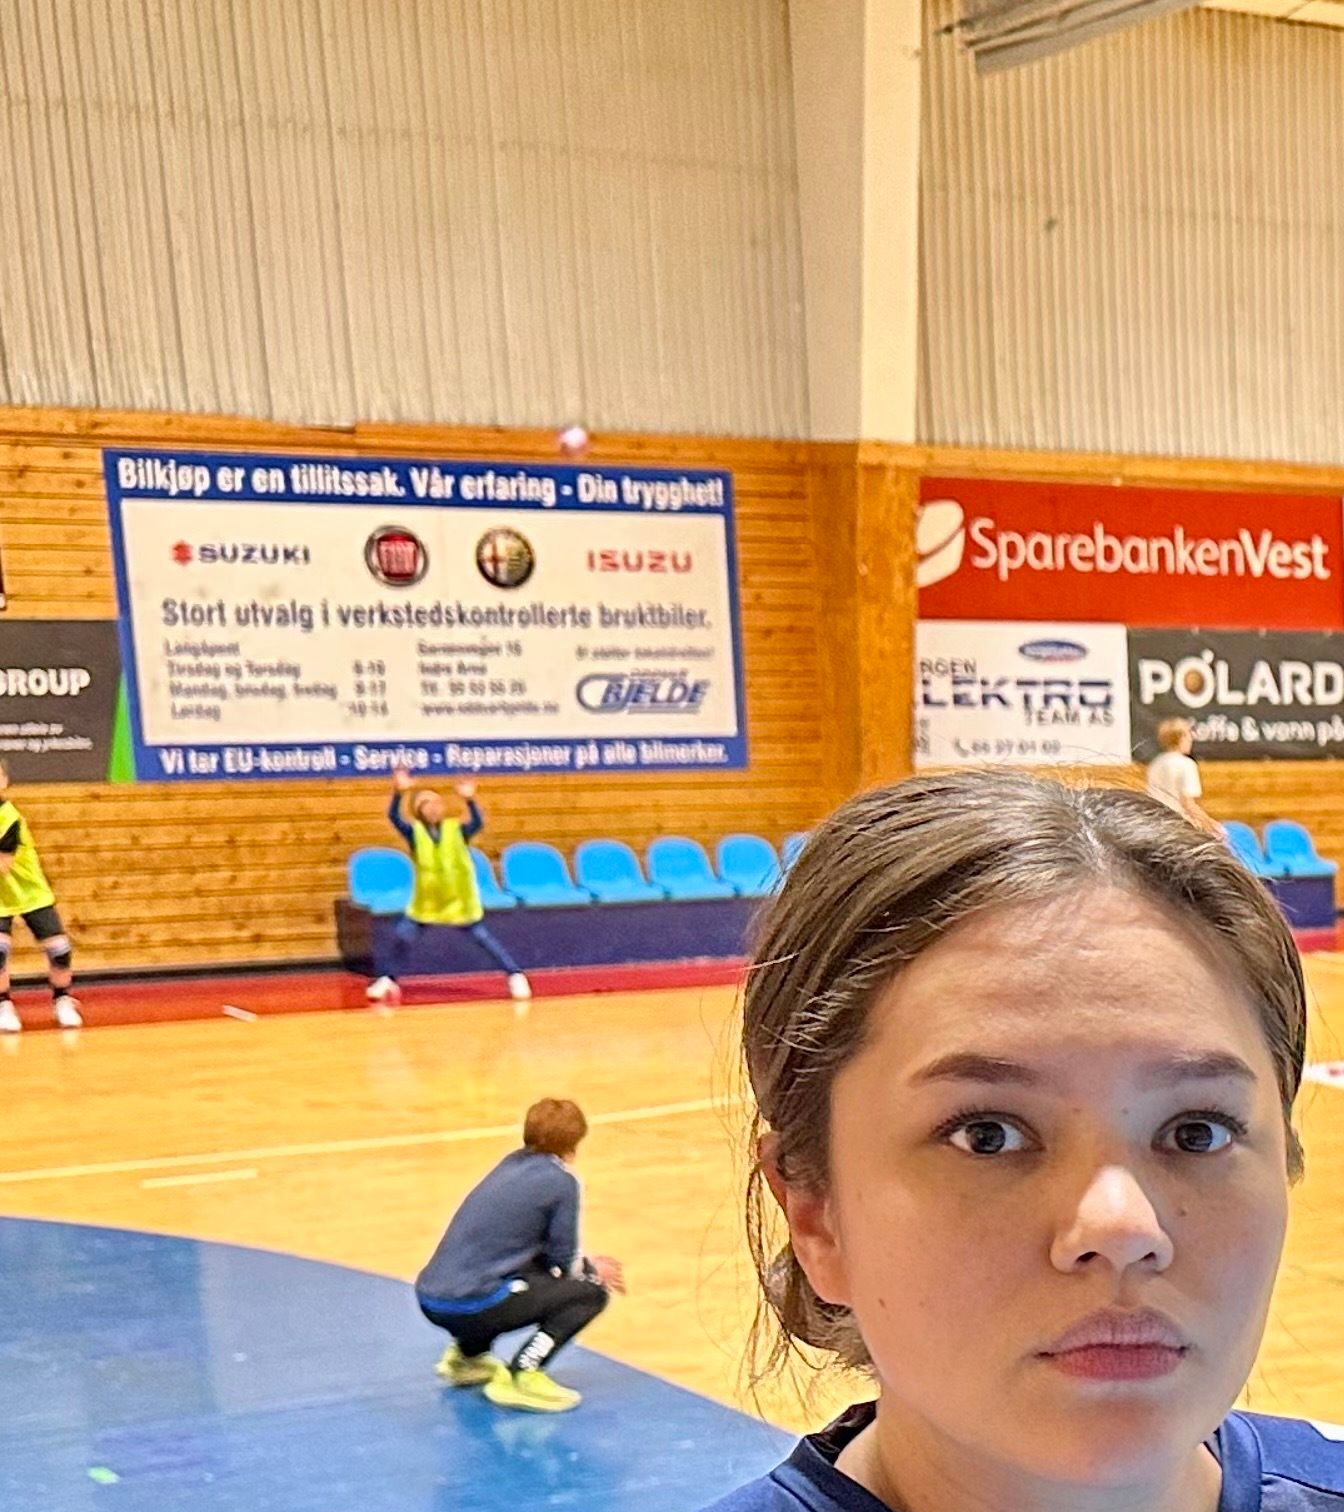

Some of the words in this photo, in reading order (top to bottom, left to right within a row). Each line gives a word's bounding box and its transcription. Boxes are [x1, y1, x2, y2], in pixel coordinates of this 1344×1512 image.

[118, 457, 210, 496] Bilkjøp
[216, 465, 246, 492] er
[252, 467, 285, 494] en
[290, 463, 405, 497] tillitssak.
[410, 466, 454, 499] Vår
[460, 470, 556, 507] erfaring
[577, 473, 618, 504] Din
[622, 476, 724, 511] trygghet!
[199, 543, 311, 565] SUZUKI
[588, 550, 693, 573] ISUZU
[970, 517, 1331, 581] SparebankenVest
[161, 597, 228, 627] Stort
[235, 599, 314, 634] utvalg
[321, 599, 330, 628] i
[339, 598, 592, 630] verkstedskontrollerte
[1241, 716, 1260, 741] &
[160, 748, 185, 774] Vi
